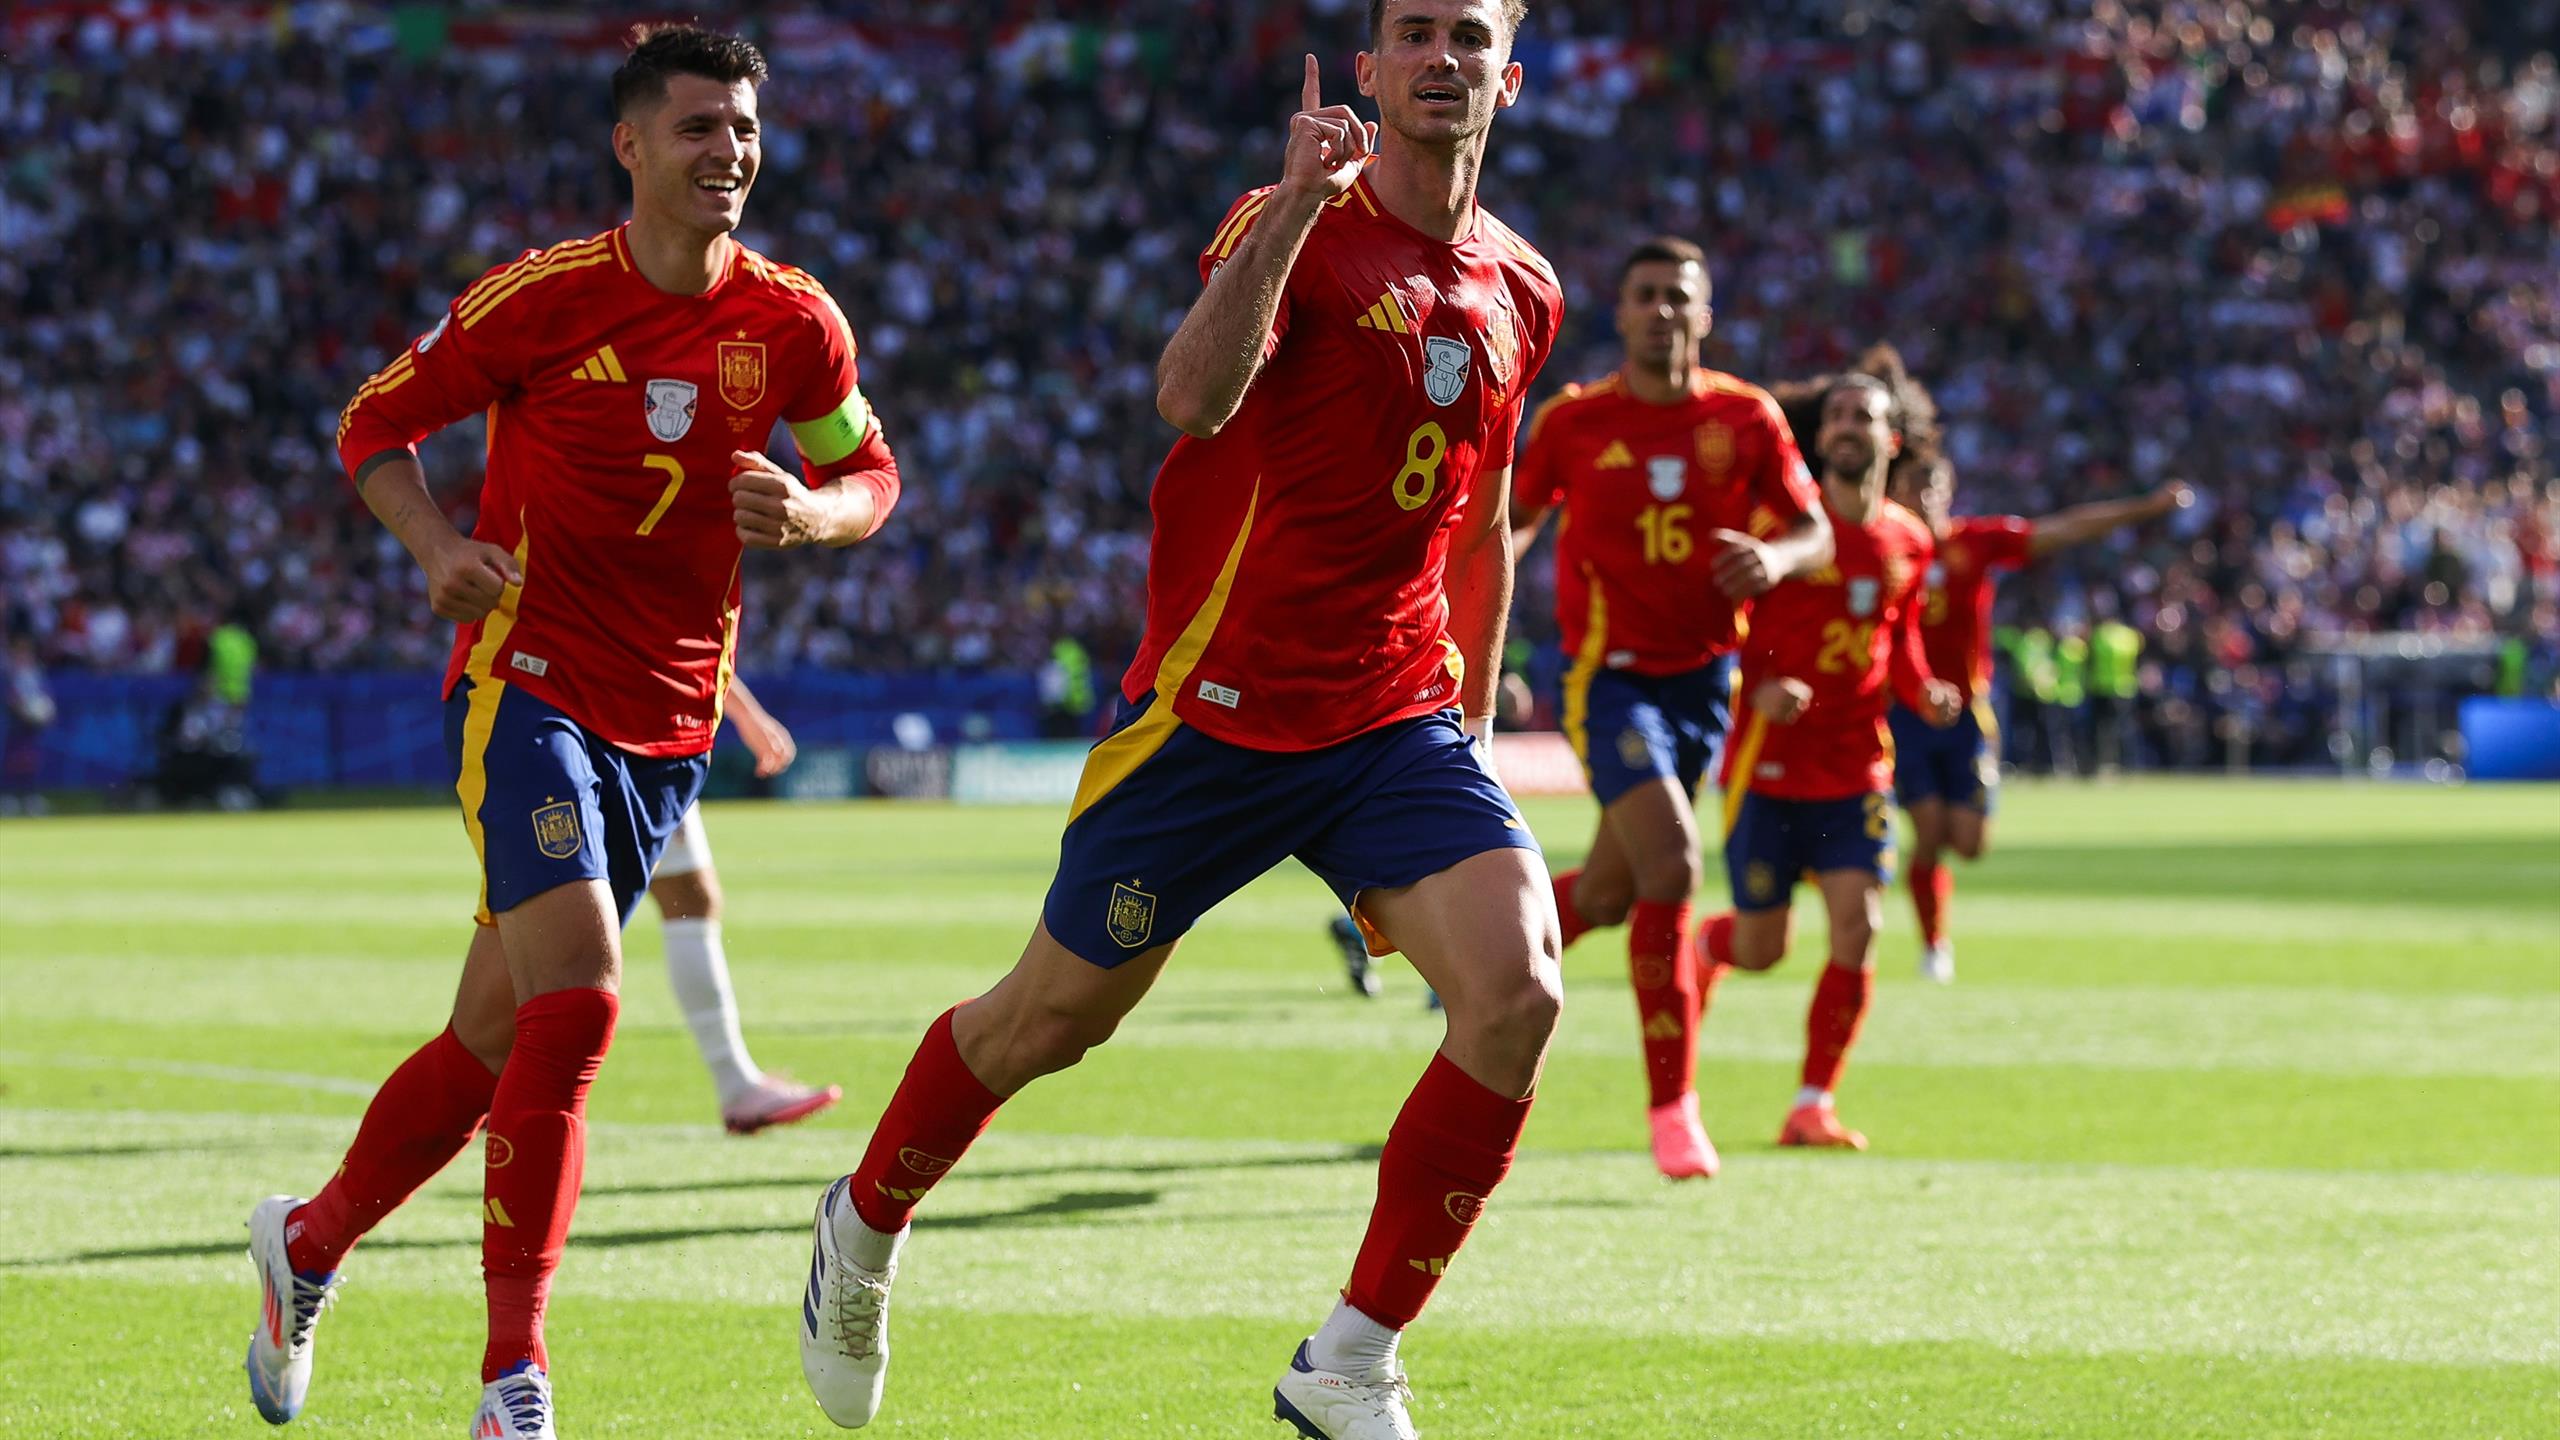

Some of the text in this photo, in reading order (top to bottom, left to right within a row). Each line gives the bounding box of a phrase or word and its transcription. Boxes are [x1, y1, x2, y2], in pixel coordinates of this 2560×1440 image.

[635, 453, 685, 536] 7
[1392, 421, 1447, 511] 8
[1634, 504, 1694, 565] 16
[1318, 1377, 1340, 1387] COPA
